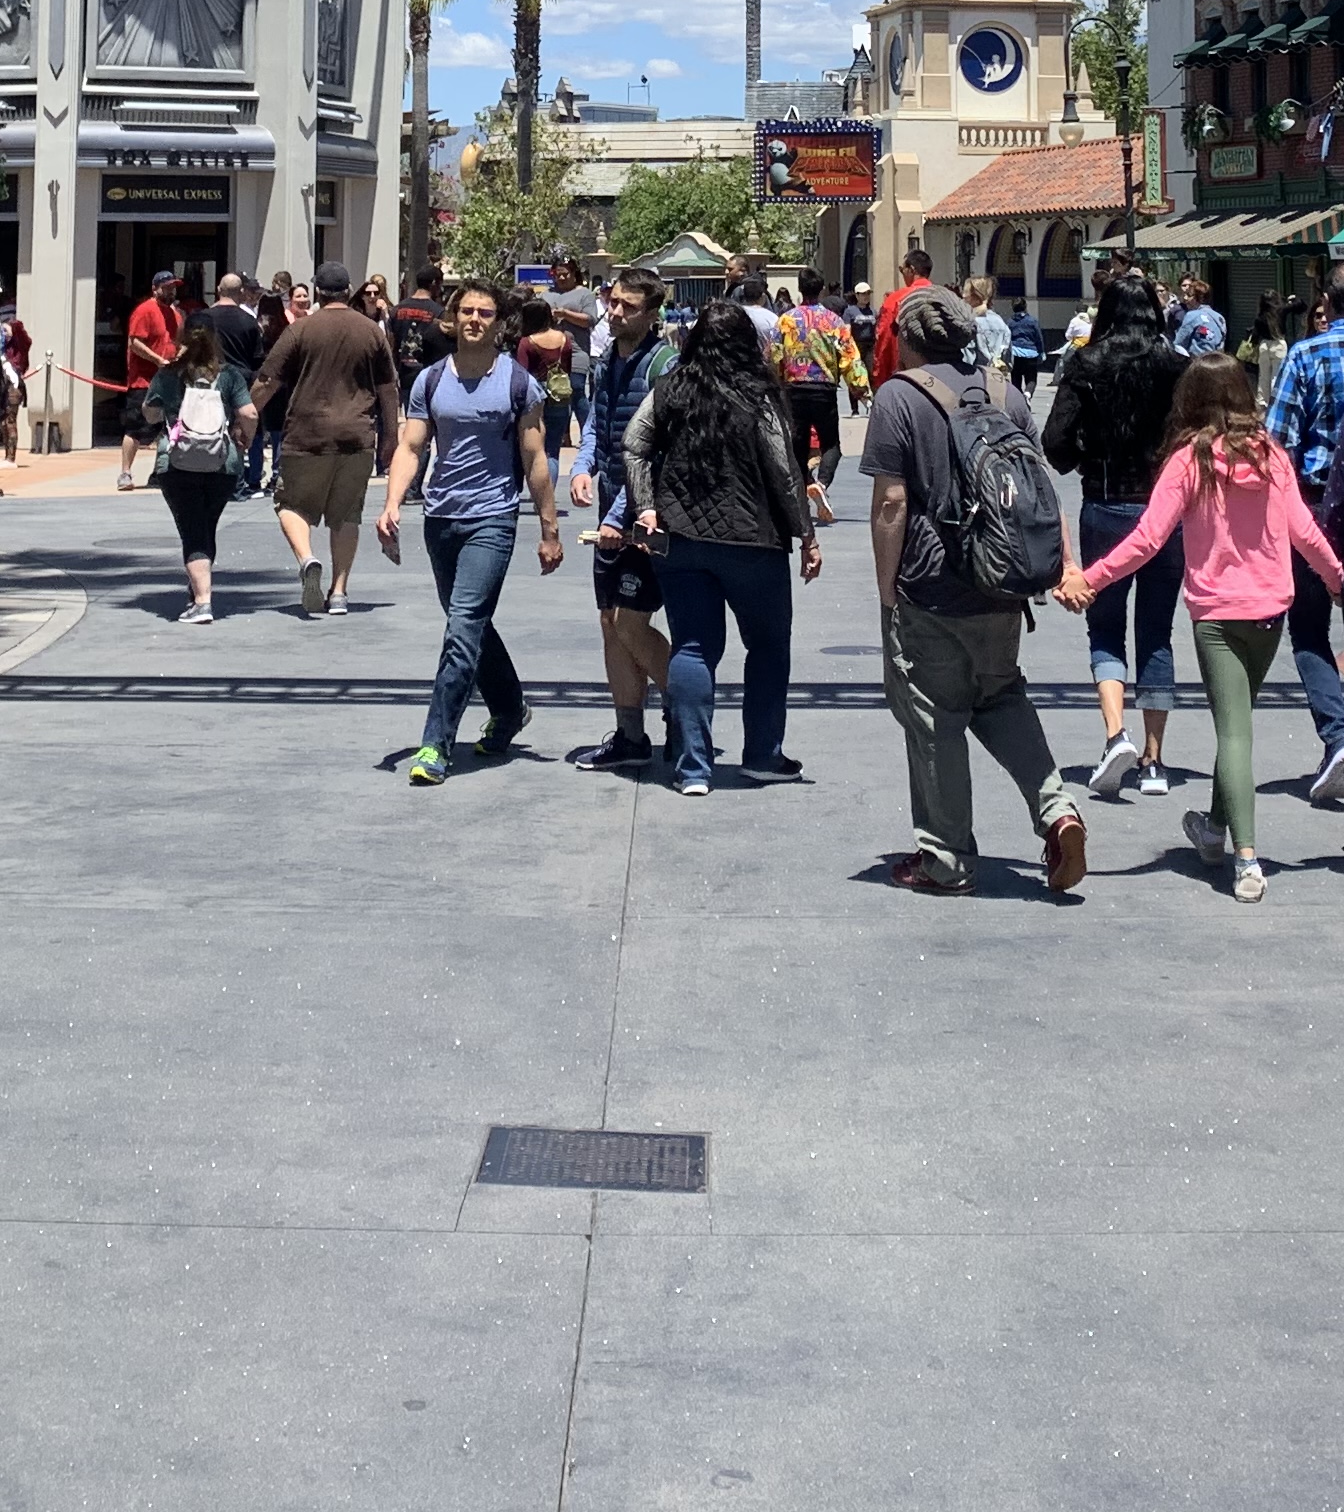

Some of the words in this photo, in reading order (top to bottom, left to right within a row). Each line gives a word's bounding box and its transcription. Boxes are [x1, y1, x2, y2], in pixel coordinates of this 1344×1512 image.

[805, 177, 849, 186] ADVENTURE
[128, 188, 181, 200] UNIVERSAL
[184, 188, 223, 200] EXPRESS
